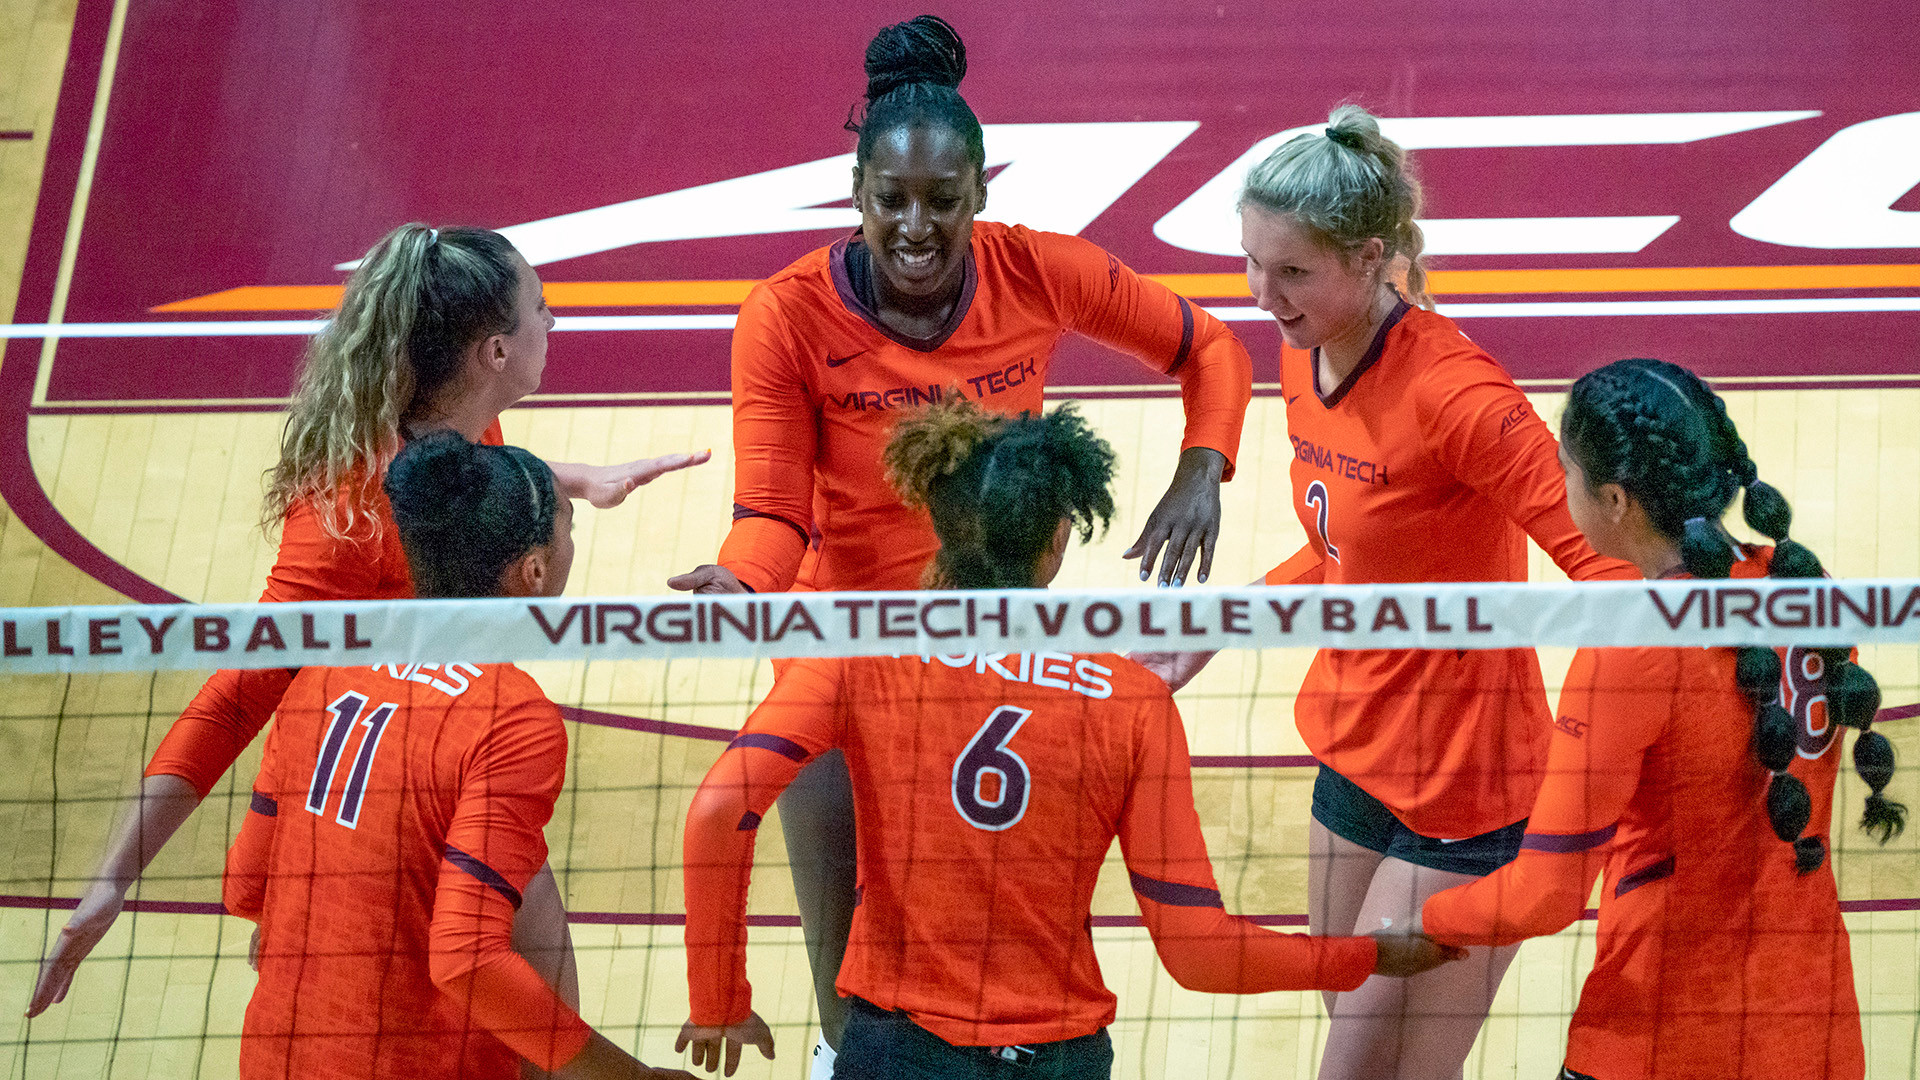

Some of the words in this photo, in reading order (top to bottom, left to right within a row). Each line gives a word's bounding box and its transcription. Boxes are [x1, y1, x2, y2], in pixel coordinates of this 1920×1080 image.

[967, 357, 1037, 399] TECH
[1500, 402, 1528, 436] ACC
[1290, 433, 1334, 473] RGINIA
[1336, 452, 1390, 486] TECH
[1305, 479, 1342, 566] 2
[528, 599, 825, 645] VIRGINIA
[834, 597, 1008, 638] TECH
[1034, 597, 1494, 637] VOLLEYBALL
[893, 650, 1113, 699] KIES
[1780, 643, 1846, 760] 8
[304, 689, 399, 831] 11
[951, 704, 1033, 832] 6
